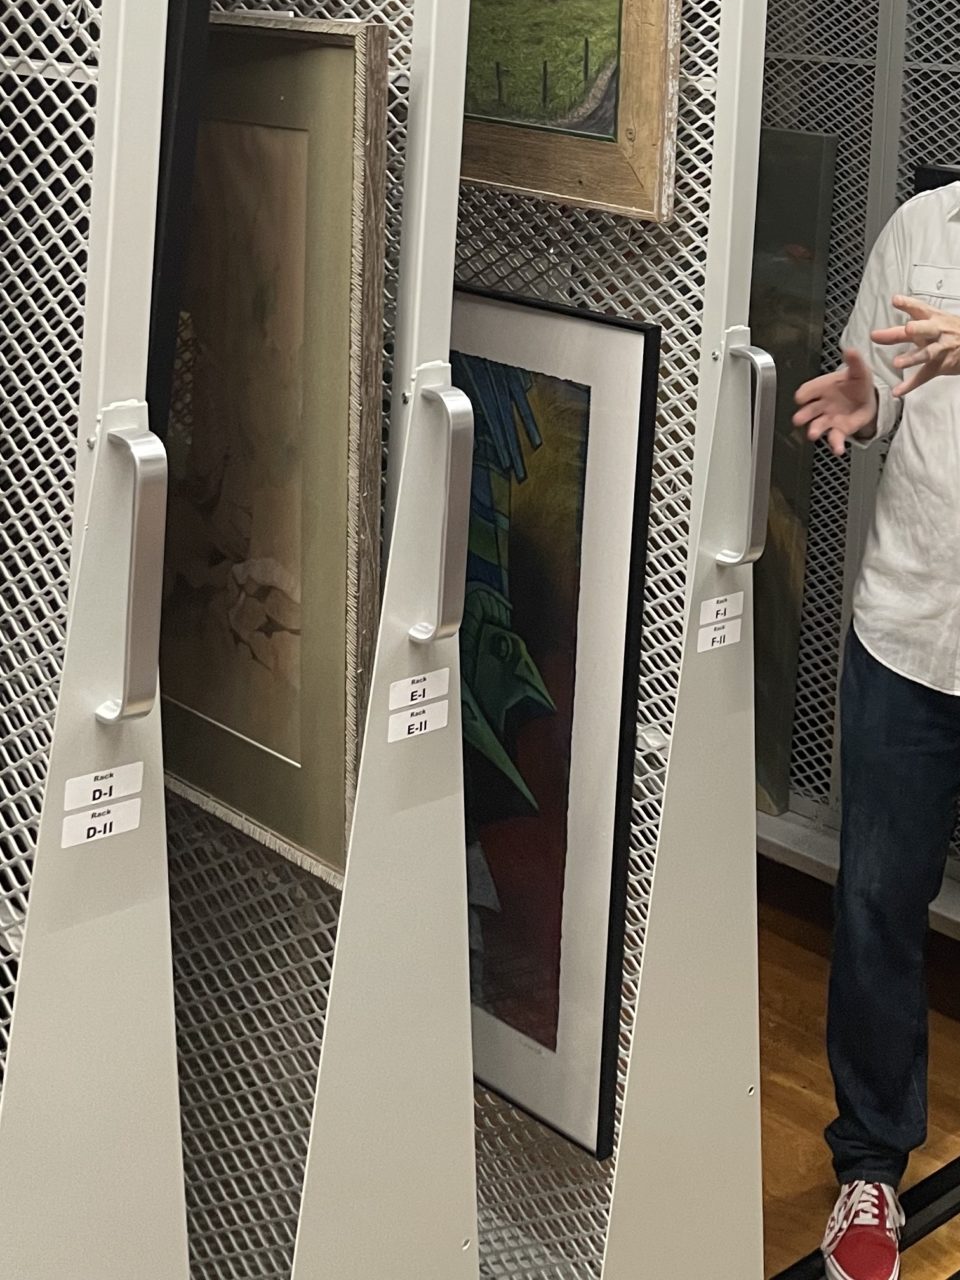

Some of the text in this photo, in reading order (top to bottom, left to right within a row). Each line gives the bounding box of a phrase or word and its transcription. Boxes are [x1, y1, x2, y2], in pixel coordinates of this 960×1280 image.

[715, 607, 727, 619] F-I
[711, 634, 726, 647] F-II
[411, 676, 427, 685] Rack
[410, 687, 426, 701] E-I
[410, 709, 426, 718] Rack
[407, 720, 427, 735] E-II
[93, 772, 114, 782] Rack
[92, 785, 113, 801] D-I
[91, 809, 111, 819] Rack
[86, 821, 113, 839] D-II
